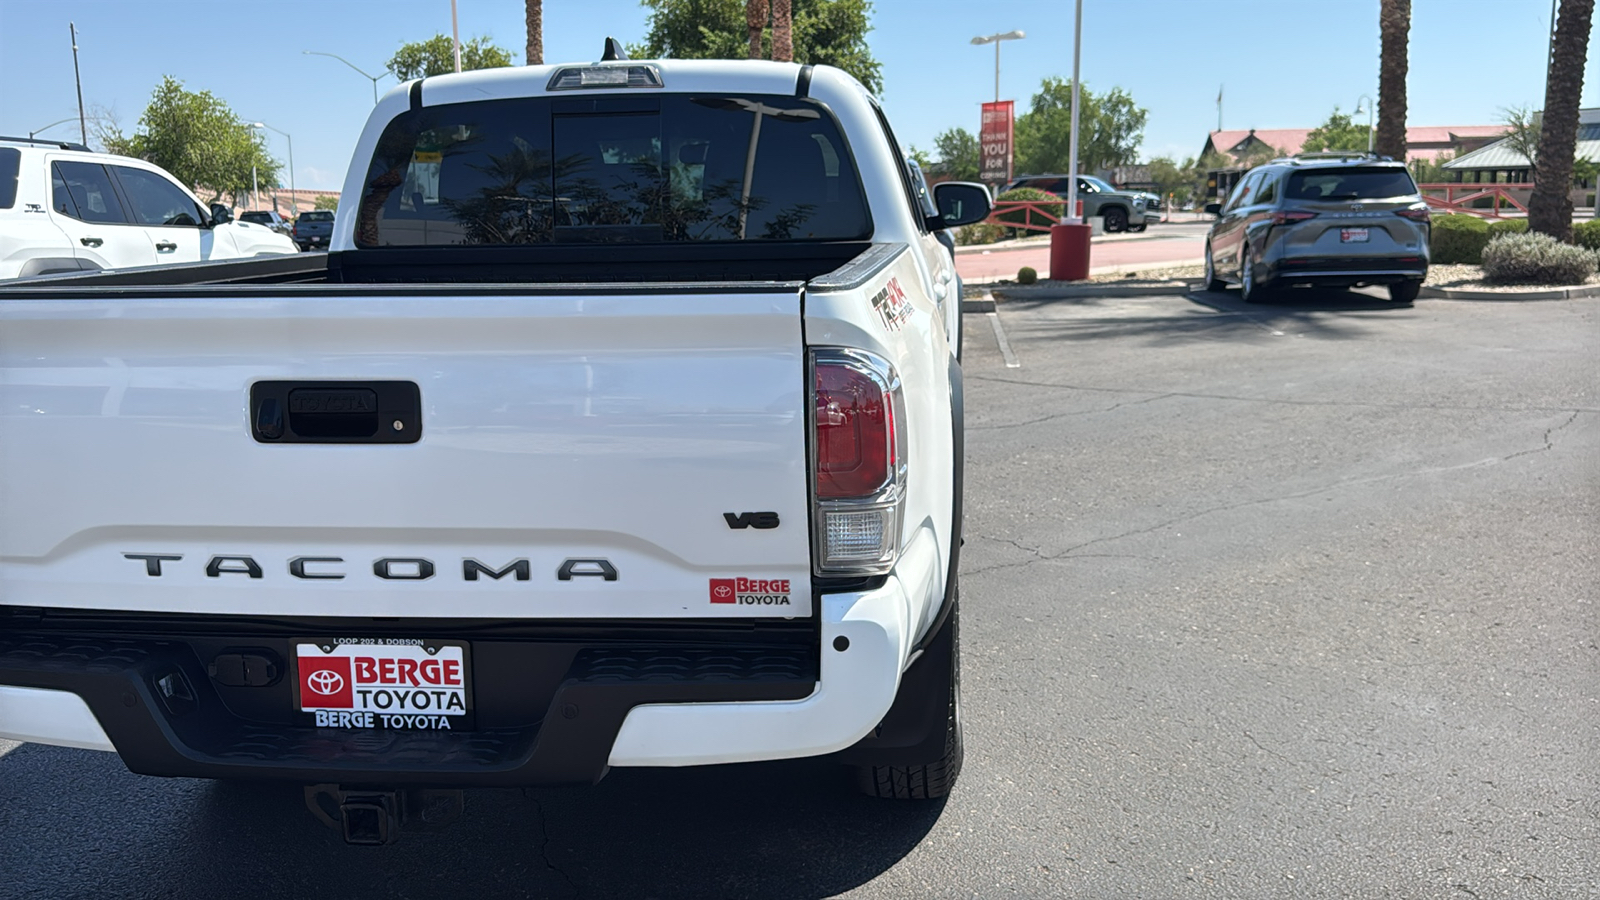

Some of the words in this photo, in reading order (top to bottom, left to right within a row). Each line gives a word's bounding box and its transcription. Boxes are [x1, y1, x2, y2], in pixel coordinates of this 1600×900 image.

[982, 143, 1007, 156] YOU
[985, 159, 1003, 169] FOR
[294, 394, 369, 412] TOYOTA
[722, 511, 780, 529] V6
[122, 552, 620, 582] TACOMA
[736, 577, 790, 594] BERGE
[737, 595, 791, 605] TOYOTA
[354, 657, 462, 687] BERGE
[356, 690, 465, 711] TOYOTA
[316, 711, 375, 729] BERGE
[380, 715, 451, 730] TOYOTA
